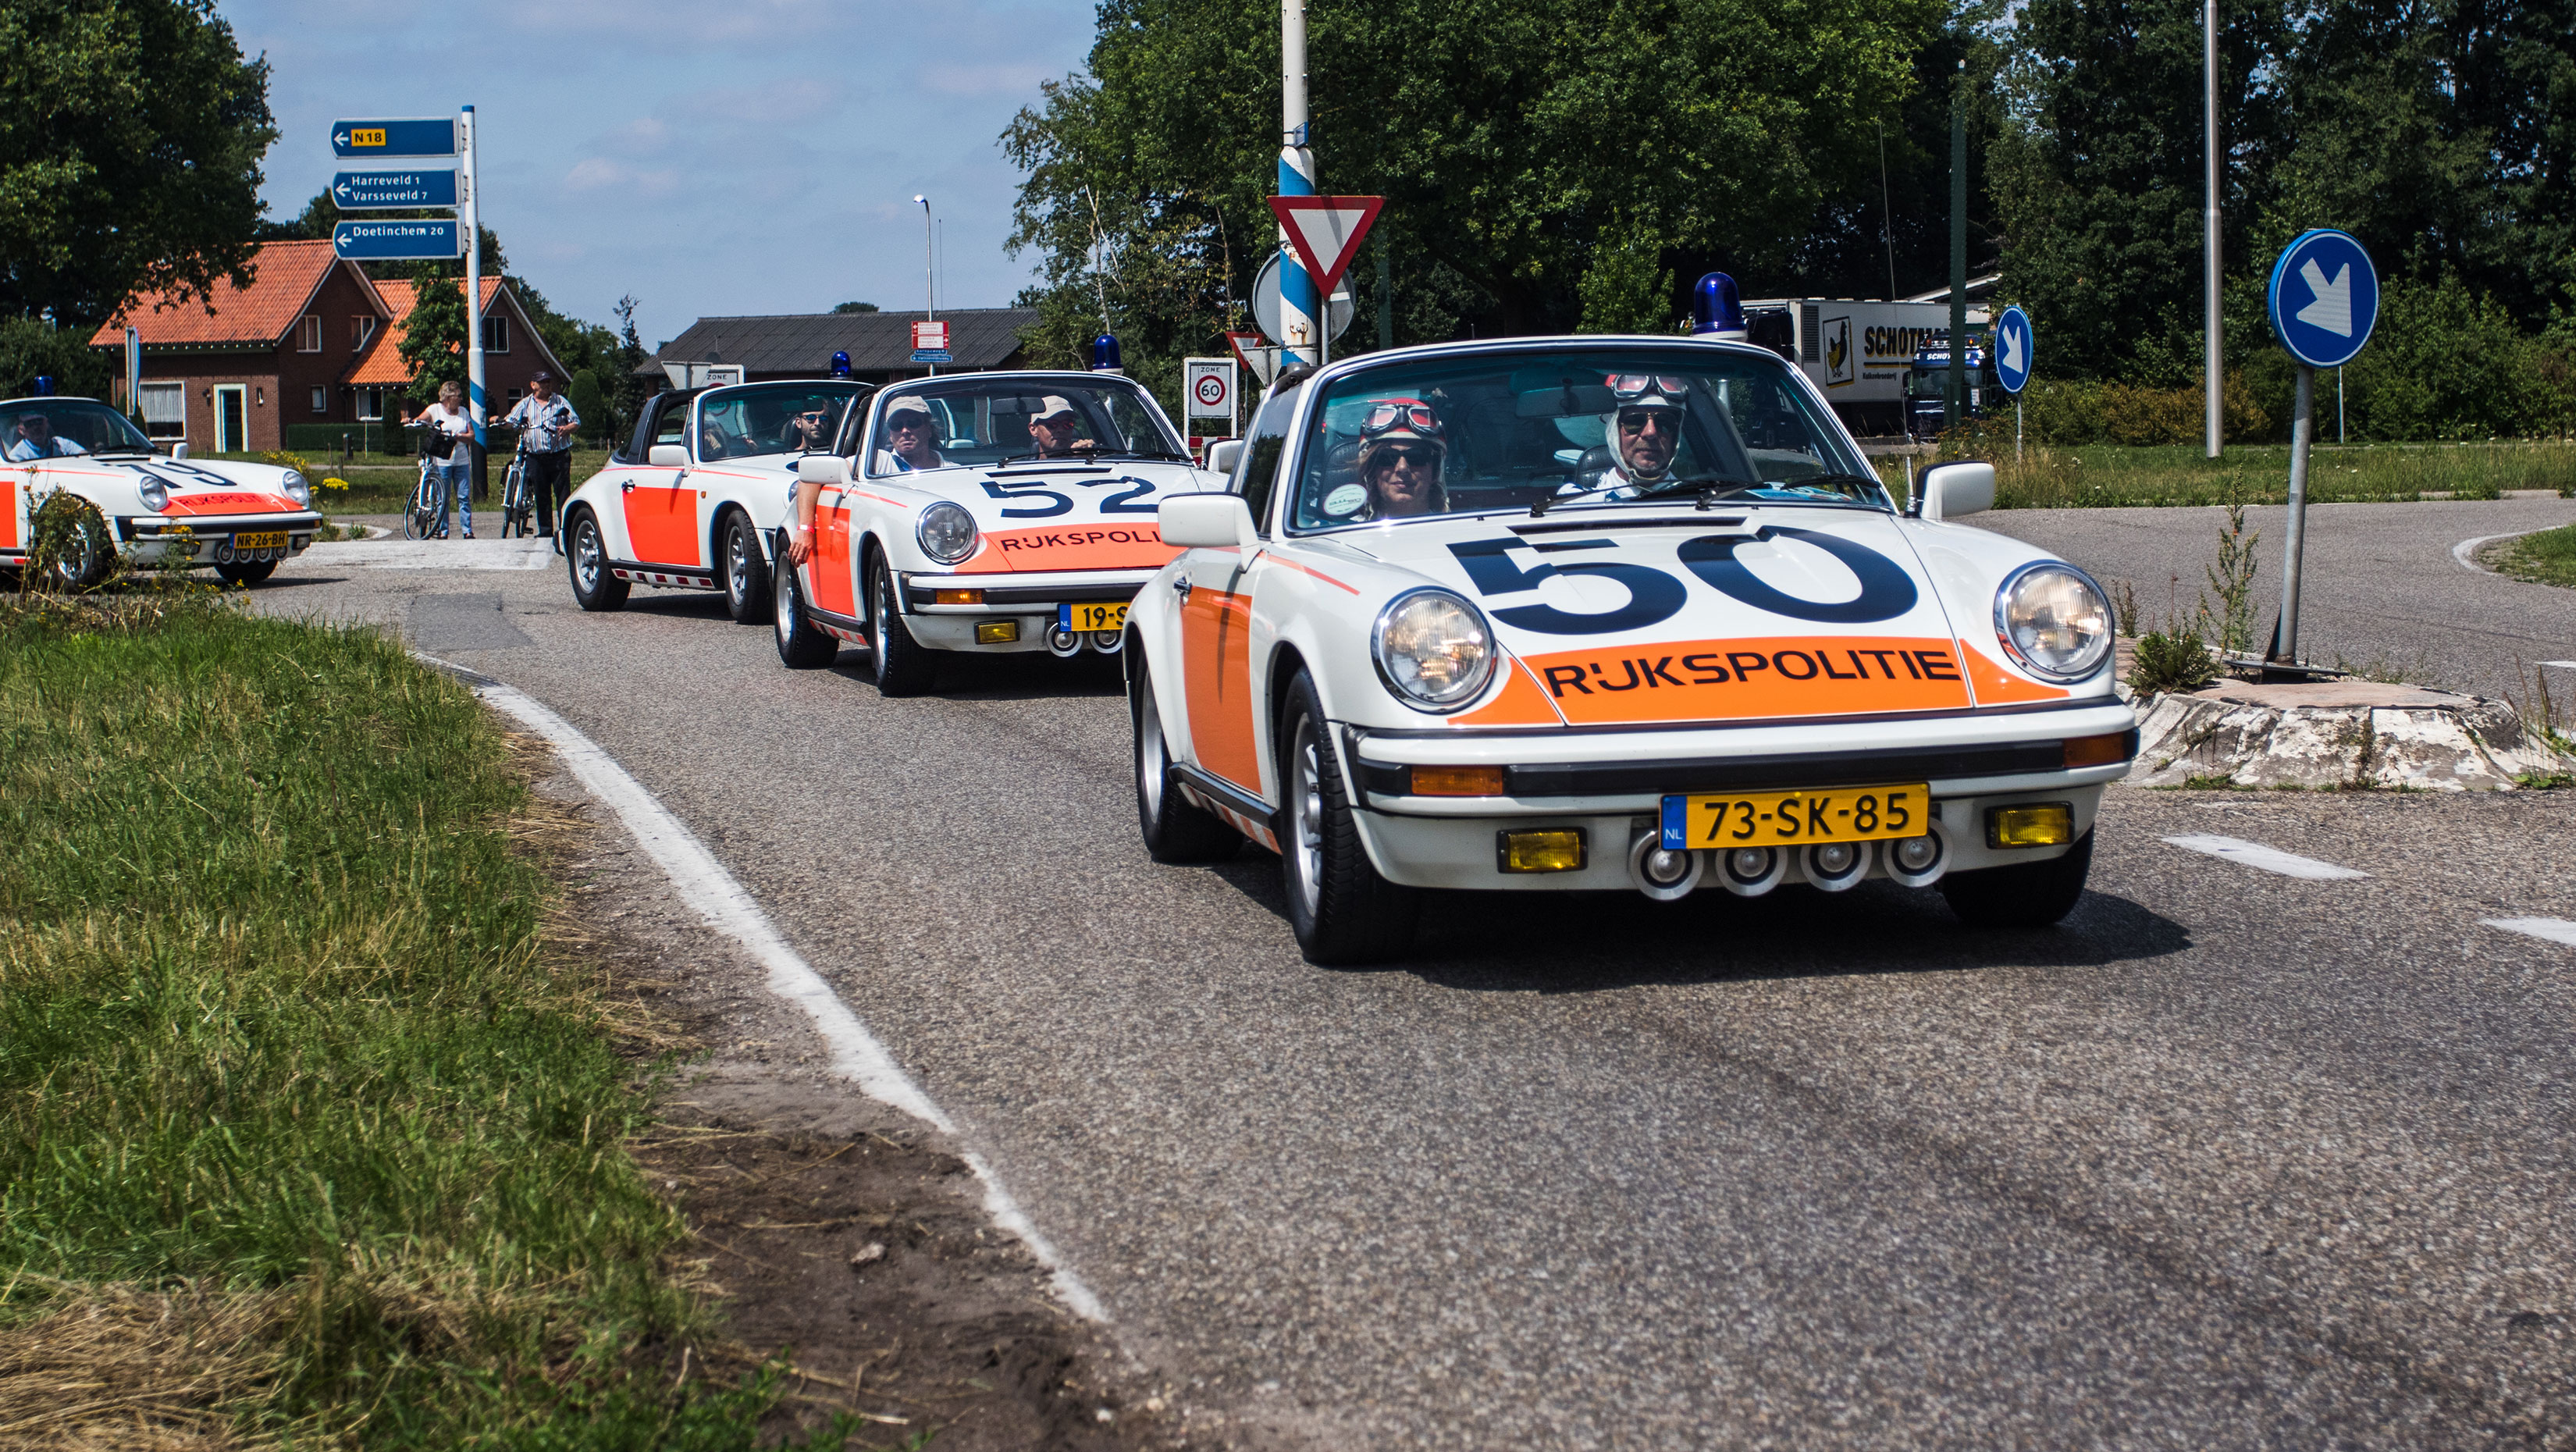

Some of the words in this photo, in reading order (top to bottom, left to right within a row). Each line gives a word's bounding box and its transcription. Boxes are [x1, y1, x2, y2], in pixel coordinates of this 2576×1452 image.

[352, 175, 411, 186] Harreveld
[415, 176, 420, 185] 1
[352, 190, 418, 201] Varsseveld
[422, 191, 428, 200] 7
[354, 226, 426, 237] Doetinchem
[1201, 385, 1219, 397] 60
[980, 475, 1159, 518] 52
[237, 532, 286, 546] NR-26-BH
[1001, 531, 1161, 551] RIJKSPOLI
[1446, 525, 1919, 635] 50
[1083, 606, 1128, 627] 19-S
[1665, 828, 1682, 840] NL
[1704, 792, 1909, 841] 73-SK-85
